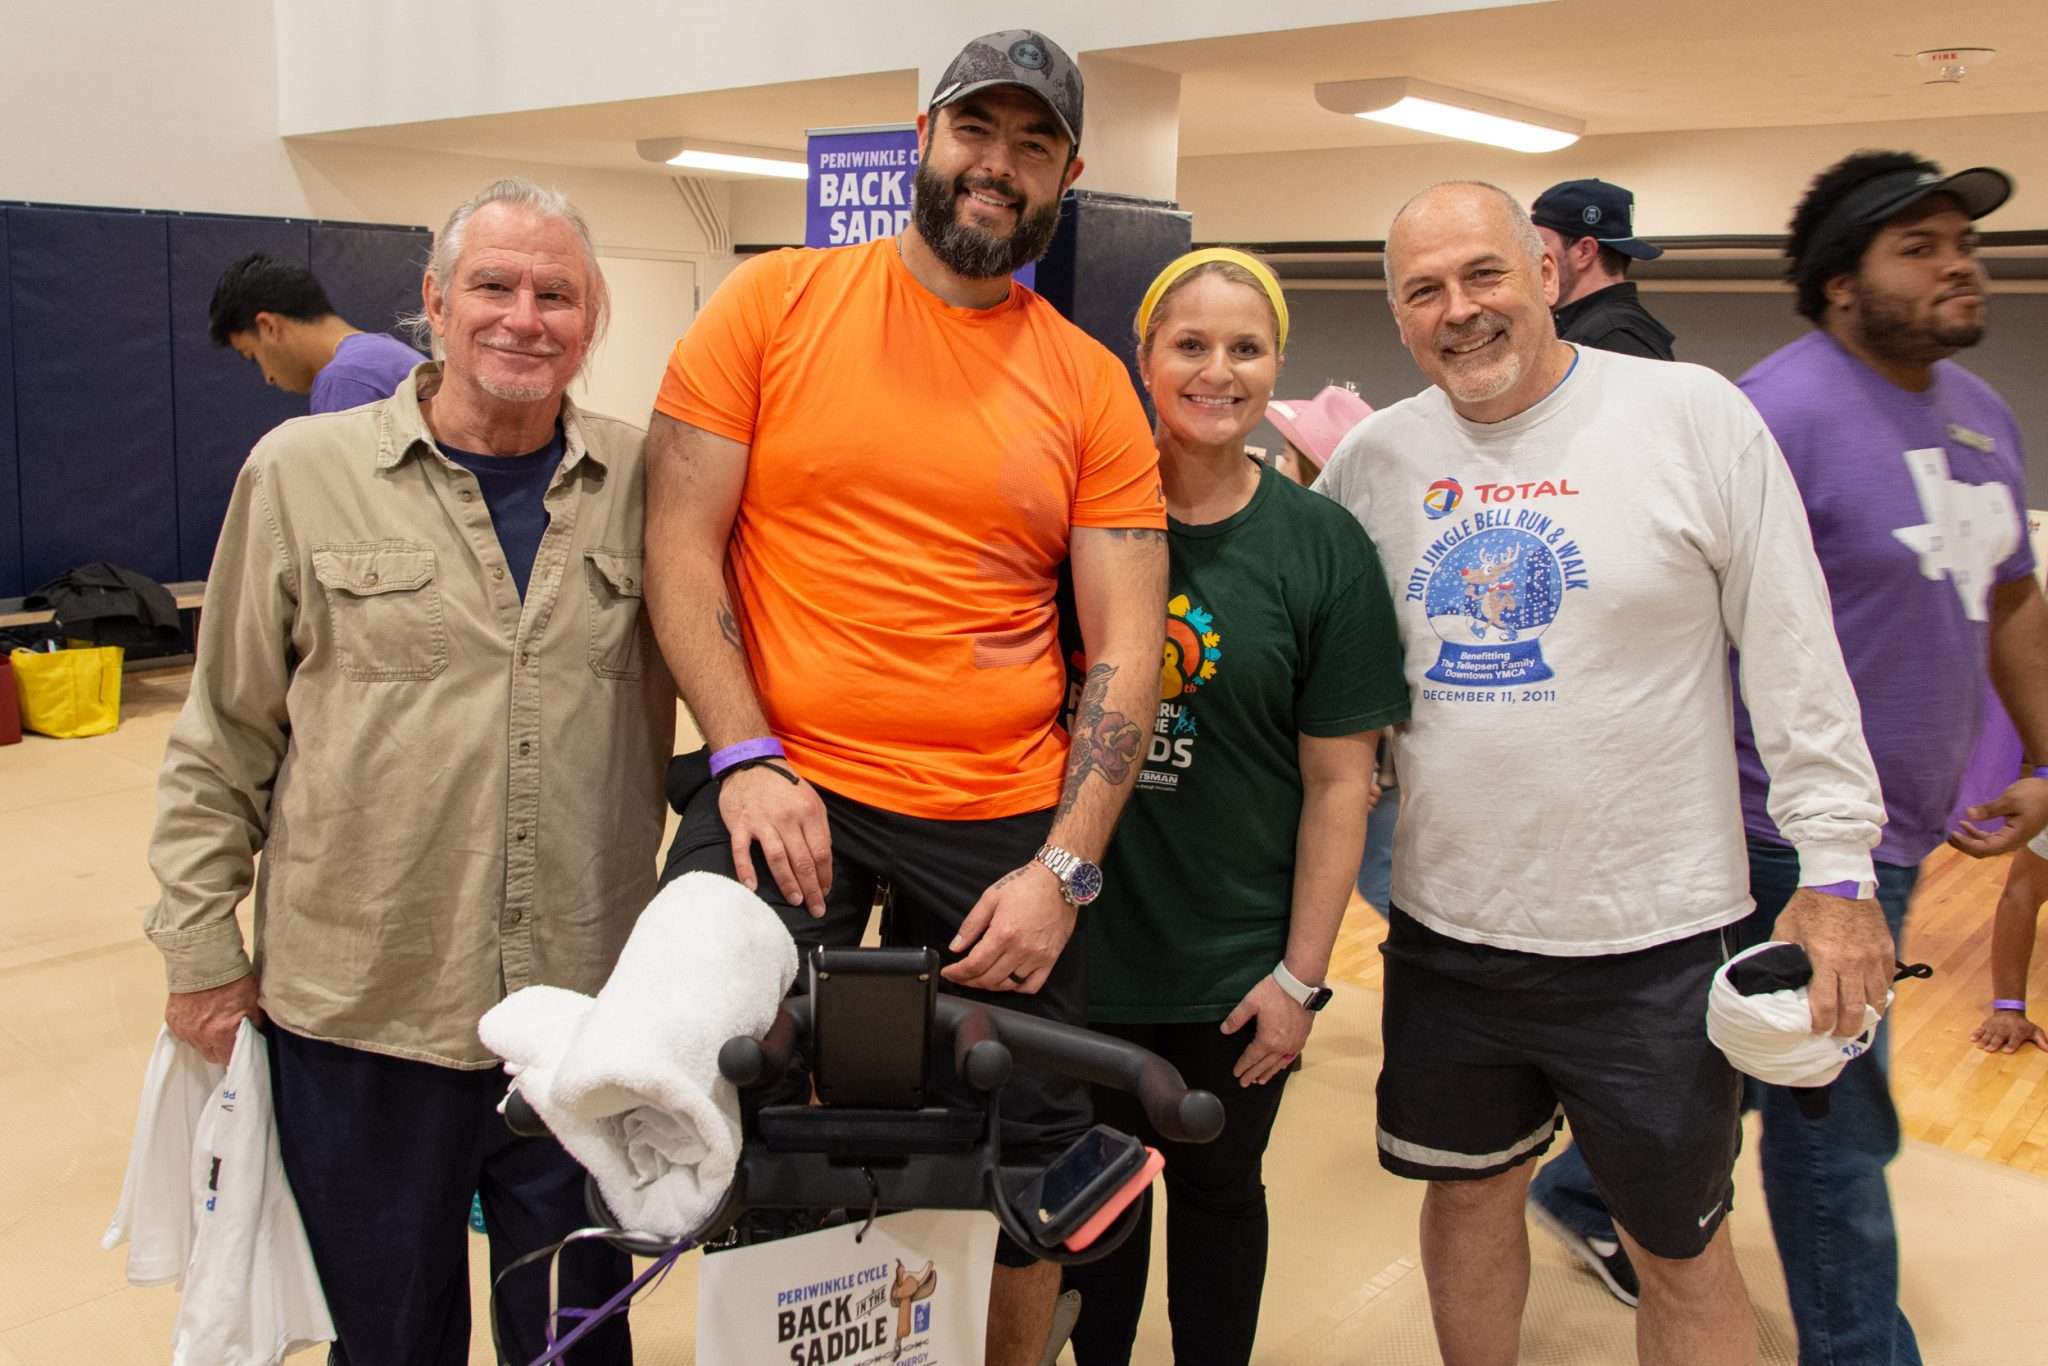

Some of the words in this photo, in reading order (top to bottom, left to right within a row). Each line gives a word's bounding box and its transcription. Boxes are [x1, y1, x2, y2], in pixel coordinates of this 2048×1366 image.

[820, 150, 906, 169] PERIWINKLE
[819, 171, 906, 207] BACK
[1474, 479, 1579, 504] TOTAL
[1474, 508, 1510, 531] BELL
[1515, 508, 1552, 536] RUN
[1422, 519, 1473, 567] JINGLE
[1546, 528, 1565, 545] &
[1555, 540, 1589, 591] WALK
[1406, 567, 1430, 602] 2011
[1441, 659, 1455, 669] The
[1501, 658, 1536, 670] Family
[1460, 650, 1511, 662] Benefitting
[1445, 668, 1493, 680] Downtown
[1495, 668, 1526, 679] YMCA
[1423, 689, 1495, 702] DECEMBER
[1501, 691, 1516, 704] 11,
[1521, 690, 1556, 702] 2011
[778, 1273, 855, 1307] PERIWINKLE
[857, 1264, 889, 1286] CYCLE
[778, 1294, 853, 1344] BACK
[856, 1300, 867, 1317] IN
[869, 1288, 886, 1307] THE
[790, 1316, 888, 1366] SADDLE
